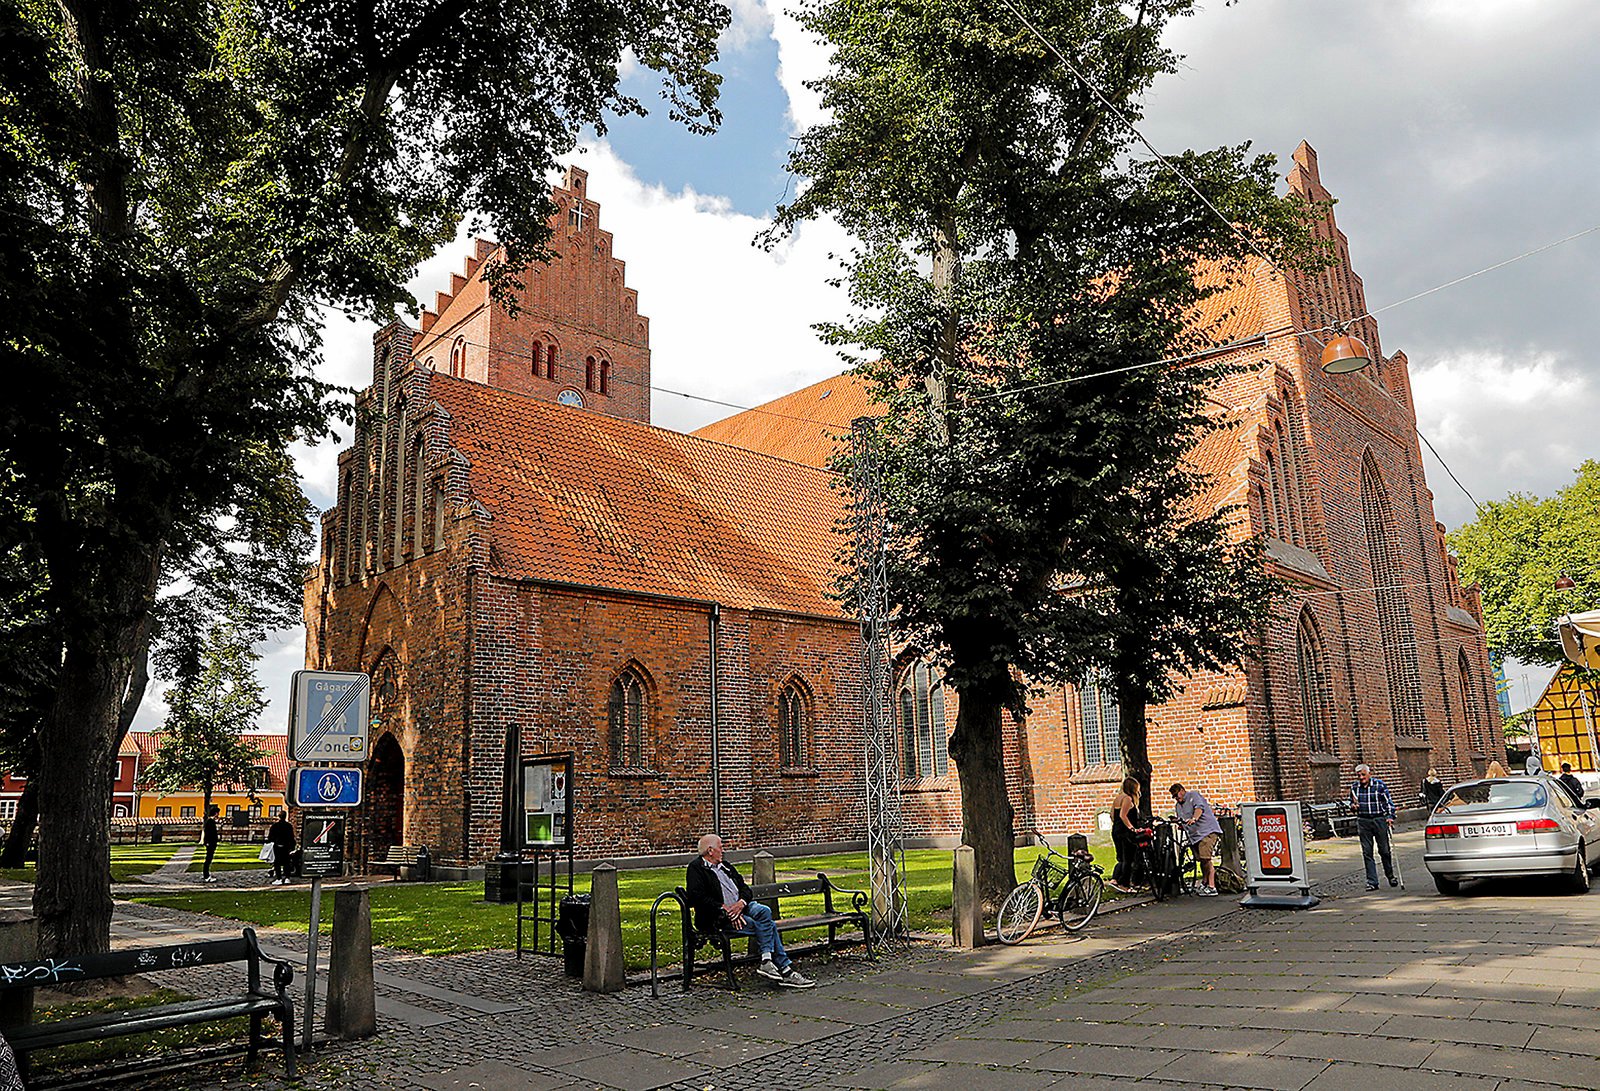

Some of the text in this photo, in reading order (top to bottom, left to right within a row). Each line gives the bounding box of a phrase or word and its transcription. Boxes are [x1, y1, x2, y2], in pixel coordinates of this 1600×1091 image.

[315, 681, 349, 693] Gågad
[315, 741, 350, 753] Zone
[1467, 827, 1479, 835] BL
[1491, 825, 1506, 833] 901
